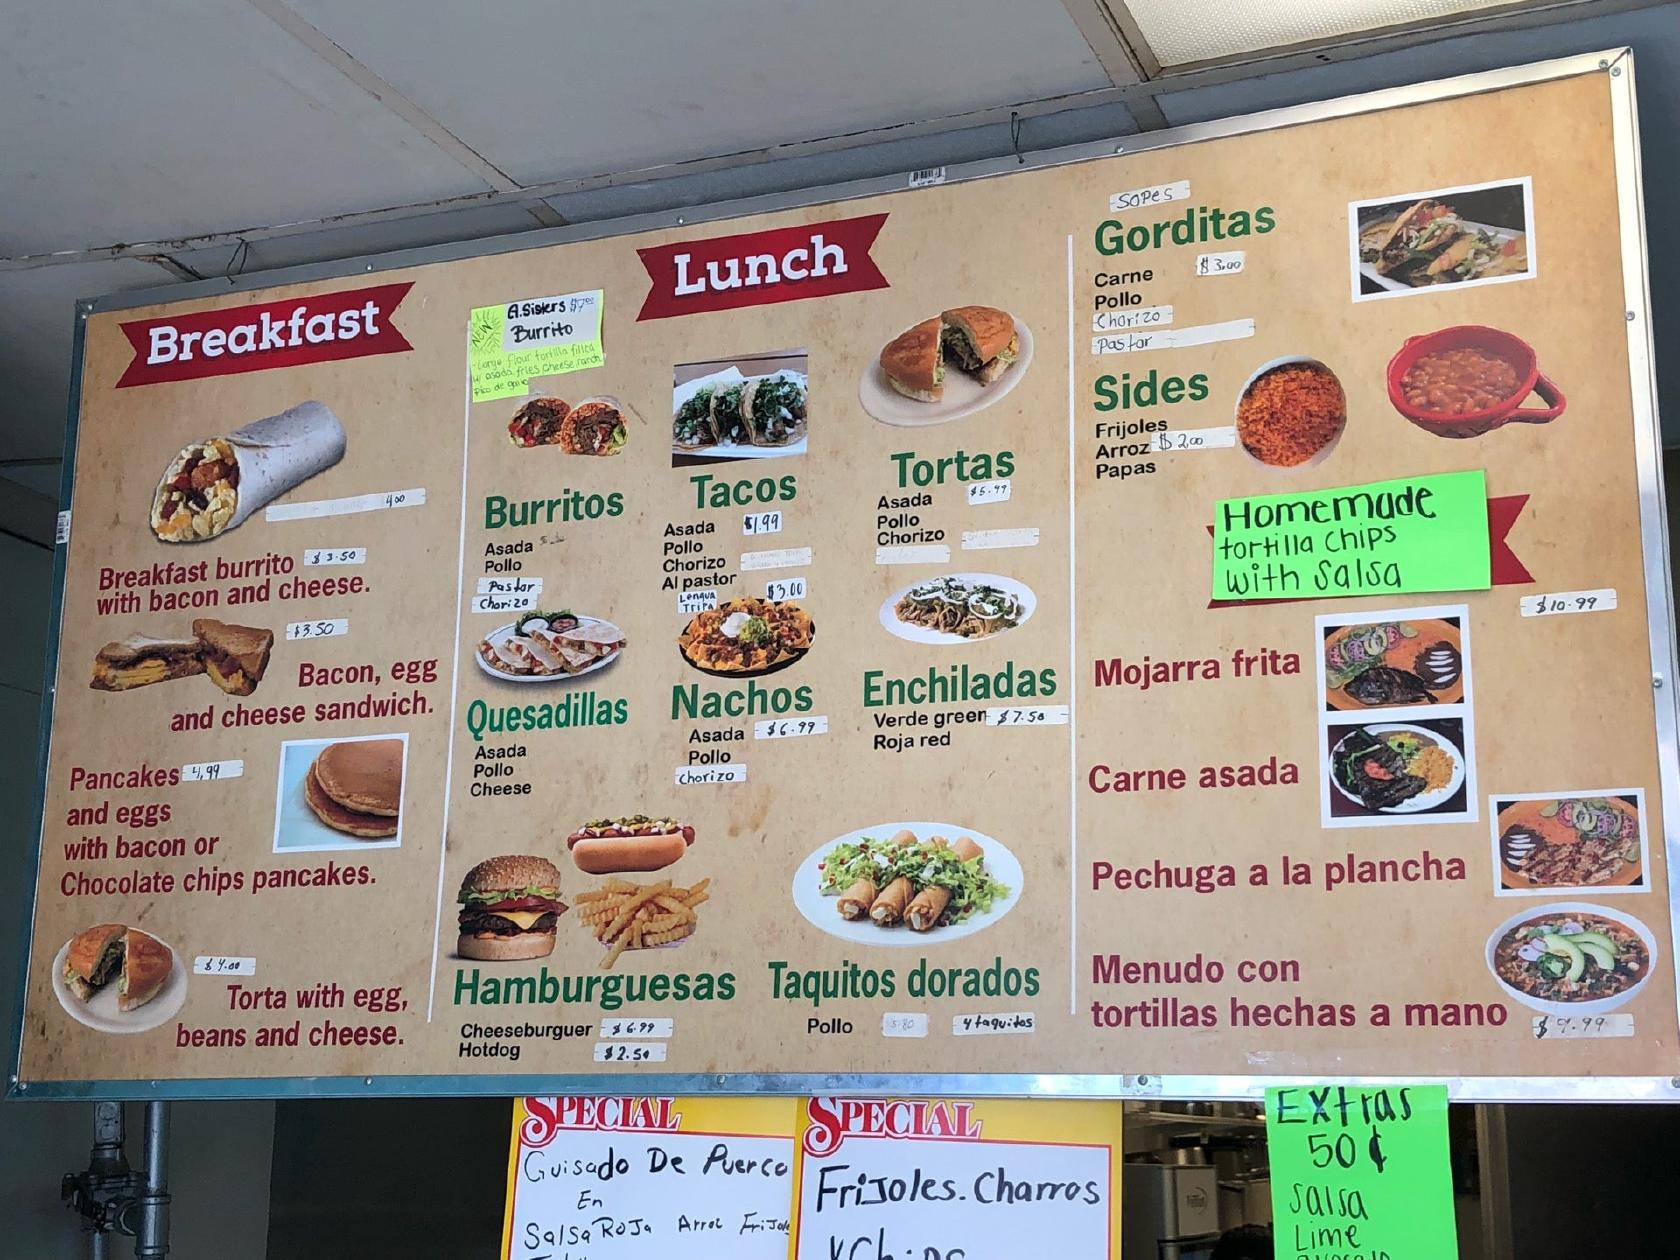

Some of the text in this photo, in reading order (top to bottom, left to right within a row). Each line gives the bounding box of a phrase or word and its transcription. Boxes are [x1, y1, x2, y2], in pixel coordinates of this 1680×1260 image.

[1095, 205, 1276, 256] Gorditas
[674, 234, 848, 296] Lunch
[1094, 269, 1153, 288] Carne
[1094, 292, 1142, 310] Pollo
[147, 301, 380, 365] Breakfast
[472, 320, 493, 347] NEW
[510, 322, 573, 343] Burrito
[1093, 369, 1209, 412] Sides
[1095, 418, 1168, 440] Frijoles
[1095, 441, 1150, 460] Arroz
[891, 450, 1016, 487] Tortas
[1096, 461, 1156, 481] Papas
[690, 474, 797, 509] Tacos
[877, 493, 932, 510] Asada
[485, 488, 624, 529] Burritos
[877, 514, 920, 529] Pollo
[1223, 485, 1437, 532] Homemade
[663, 521, 715, 537] Asada
[877, 528, 945, 546] Chorizo
[1218, 522, 1314, 560] tortilla
[485, 541, 533, 556] Asada
[664, 540, 703, 556] Pollo
[99, 553, 294, 590] Breakfast burrito
[485, 558, 522, 573] Pollo
[662, 556, 726, 573] Chorizo
[1226, 562, 1300, 594] with
[97, 573, 370, 616] with bacon and cheese.
[662, 572, 737, 592] Al pastor
[298, 658, 438, 687] Bacon, egg
[1094, 647, 1301, 690] Mojarra frita
[864, 660, 1057, 707] Enchiladas
[171, 690, 434, 731] and cheese sandwich.
[672, 680, 813, 720] Nachos
[467, 691, 628, 741] Quesadillas
[874, 711, 987, 730] Verde green
[689, 727, 745, 744] Asada
[874, 731, 951, 752] Roja red
[474, 744, 526, 760] Asada
[689, 749, 731, 765] Pollo
[70, 764, 180, 791] Pancakes
[474, 763, 514, 778] Pollo
[1088, 756, 1299, 793] Carne asada
[470, 782, 532, 797] Cheese
[67, 801, 171, 829] and eggs
[64, 834, 220, 861] with bacon or
[60, 861, 377, 896] Chocolate chips pancakes.
[1092, 851, 1466, 894] Pechuga a la plancha
[768, 956, 1040, 1007] Taquitos dorados
[1092, 953, 1300, 985] Menudo con
[227, 983, 408, 1012] Torta with egg,
[453, 967, 737, 1010] Hamburguesas
[807, 1018, 853, 1034] Pollo
[975, 1015, 1033, 1031] taquitos
[1091, 996, 1508, 1029] tortillas hechas a mano
[176, 1020, 404, 1048] beans and cheese.
[461, 1022, 593, 1040] Cheeseburguer
[459, 1042, 521, 1060] Hotdog
[1277, 1086, 1412, 1127] Extras
[524, 1143, 788, 1182] Guisado De Puerco
[974, 1167, 1101, 1204] Charros
[577, 1190, 603, 1210] En
